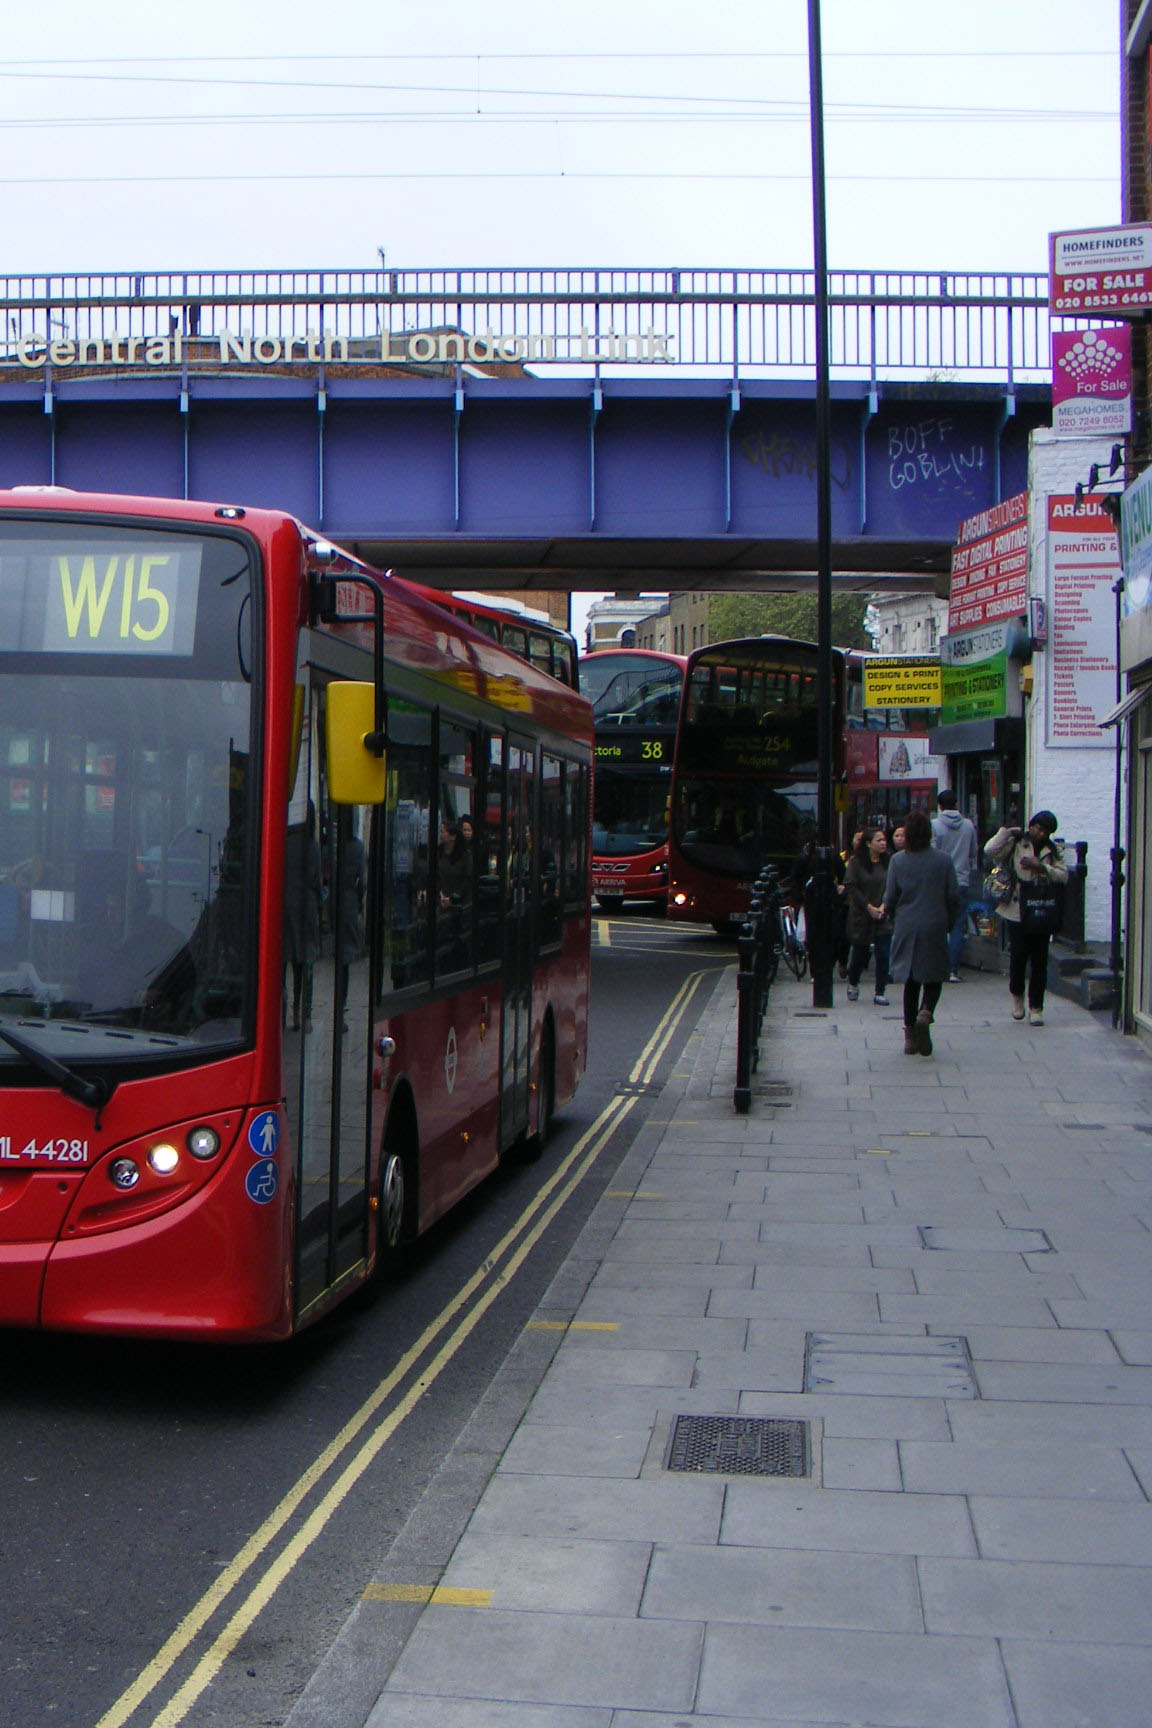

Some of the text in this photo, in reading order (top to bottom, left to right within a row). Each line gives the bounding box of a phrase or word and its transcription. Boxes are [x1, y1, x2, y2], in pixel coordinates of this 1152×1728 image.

[1063, 236, 1144, 253] HOMEFINDERS
[1064, 255, 1144, 267] WWW.HOMEFINDERS.NET
[1063, 273, 1145, 293] FOR SALE
[1055, 297, 1081, 309] 020
[1084, 294, 1118, 307] 8533
[16, 329, 182, 369] Central
[219, 327, 348, 365] North
[381, 326, 553, 363] London
[580, 326, 675, 362] Link
[1076, 380, 1128, 393] For Sale
[1058, 403, 1125, 417] MEGAHOMES
[1059, 418, 1076, 427] 020
[952, 526, 1027, 571] FAST DIGITAL PRINTING
[1054, 542, 1117, 553] PRINTING &
[58, 553, 171, 641] W15
[959, 605, 983, 625] SUPPLIES
[986, 593, 1026, 618] CONSUMABLES
[867, 671, 901, 680] DESIGN
[913, 670, 940, 678] PRINT
[869, 682, 939, 692] COPY SERVICES
[876, 696, 931, 705] STATIONERY
[594, 742, 663, 759] toria 38
